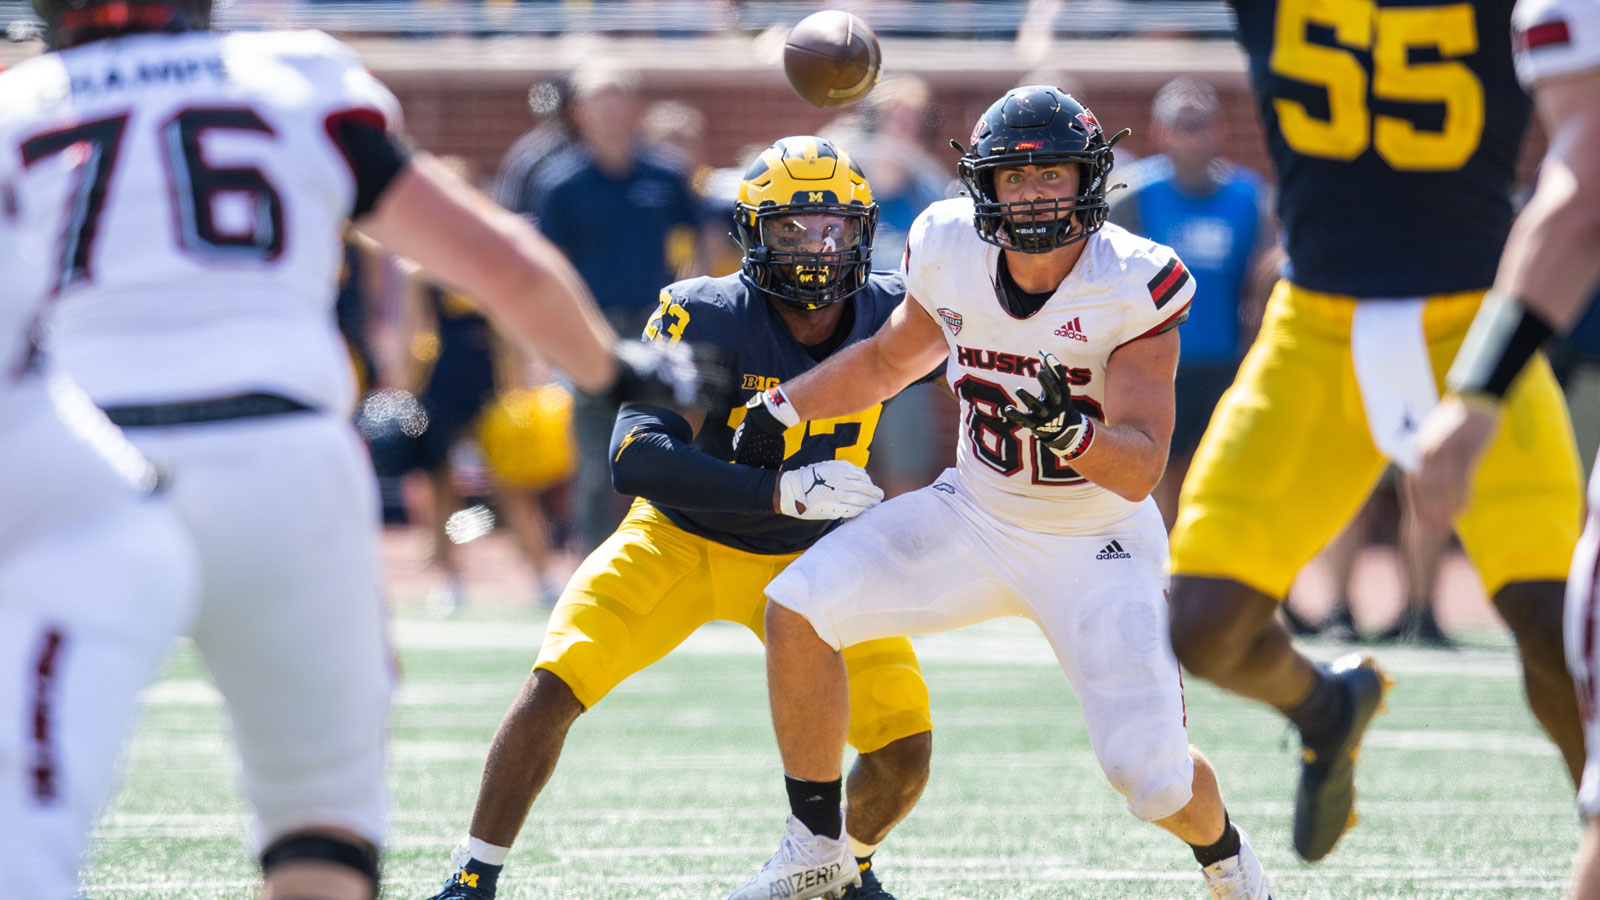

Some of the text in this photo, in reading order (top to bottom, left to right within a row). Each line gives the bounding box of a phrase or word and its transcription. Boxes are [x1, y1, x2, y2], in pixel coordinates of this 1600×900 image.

[1269, 0, 1485, 171] 55
[20, 106, 286, 301] 76
[808, 191, 824, 203] M
[1053, 328, 1089, 343] adidas
[956, 344, 1093, 387] HUSKS
[1095, 552, 1132, 560] adidas
[459, 870, 480, 888] M
